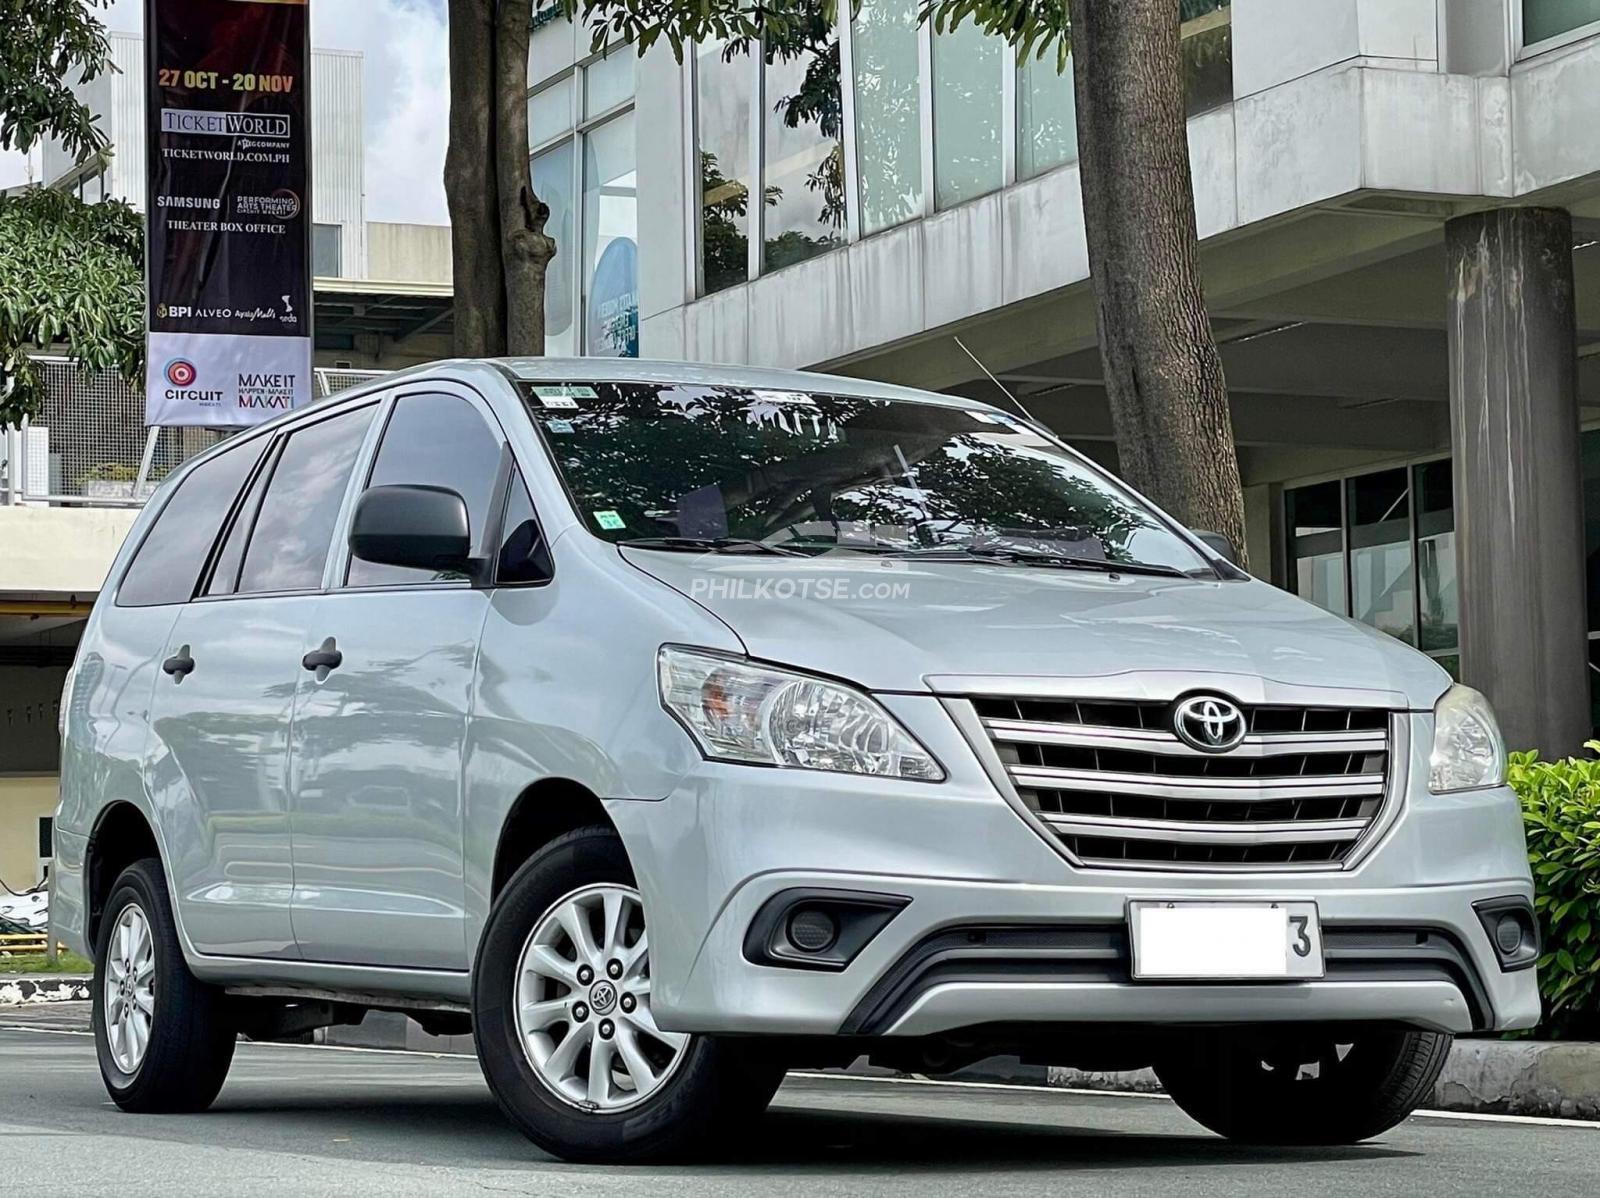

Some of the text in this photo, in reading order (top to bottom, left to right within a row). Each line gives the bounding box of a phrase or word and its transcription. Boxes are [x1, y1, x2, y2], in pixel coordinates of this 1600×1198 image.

[159, 69, 180, 87] 27
[184, 70, 218, 89] OCT
[232, 74, 256, 91] 20
[259, 75, 293, 92] NOV
[163, 149, 290, 163] TICKETWORLD.COM.PH
[157, 196, 221, 209] SAMSUNG
[237, 196, 294, 205] PERFORMING
[167, 220, 286, 234] THEATER BOX OFFICE
[169, 306, 191, 318] BPI
[195, 309, 231, 318] ALVEO
[238, 374, 281, 387] MAKE
[238, 395, 294, 408] MAKATI
[1289, 915, 1311, 957] 3
